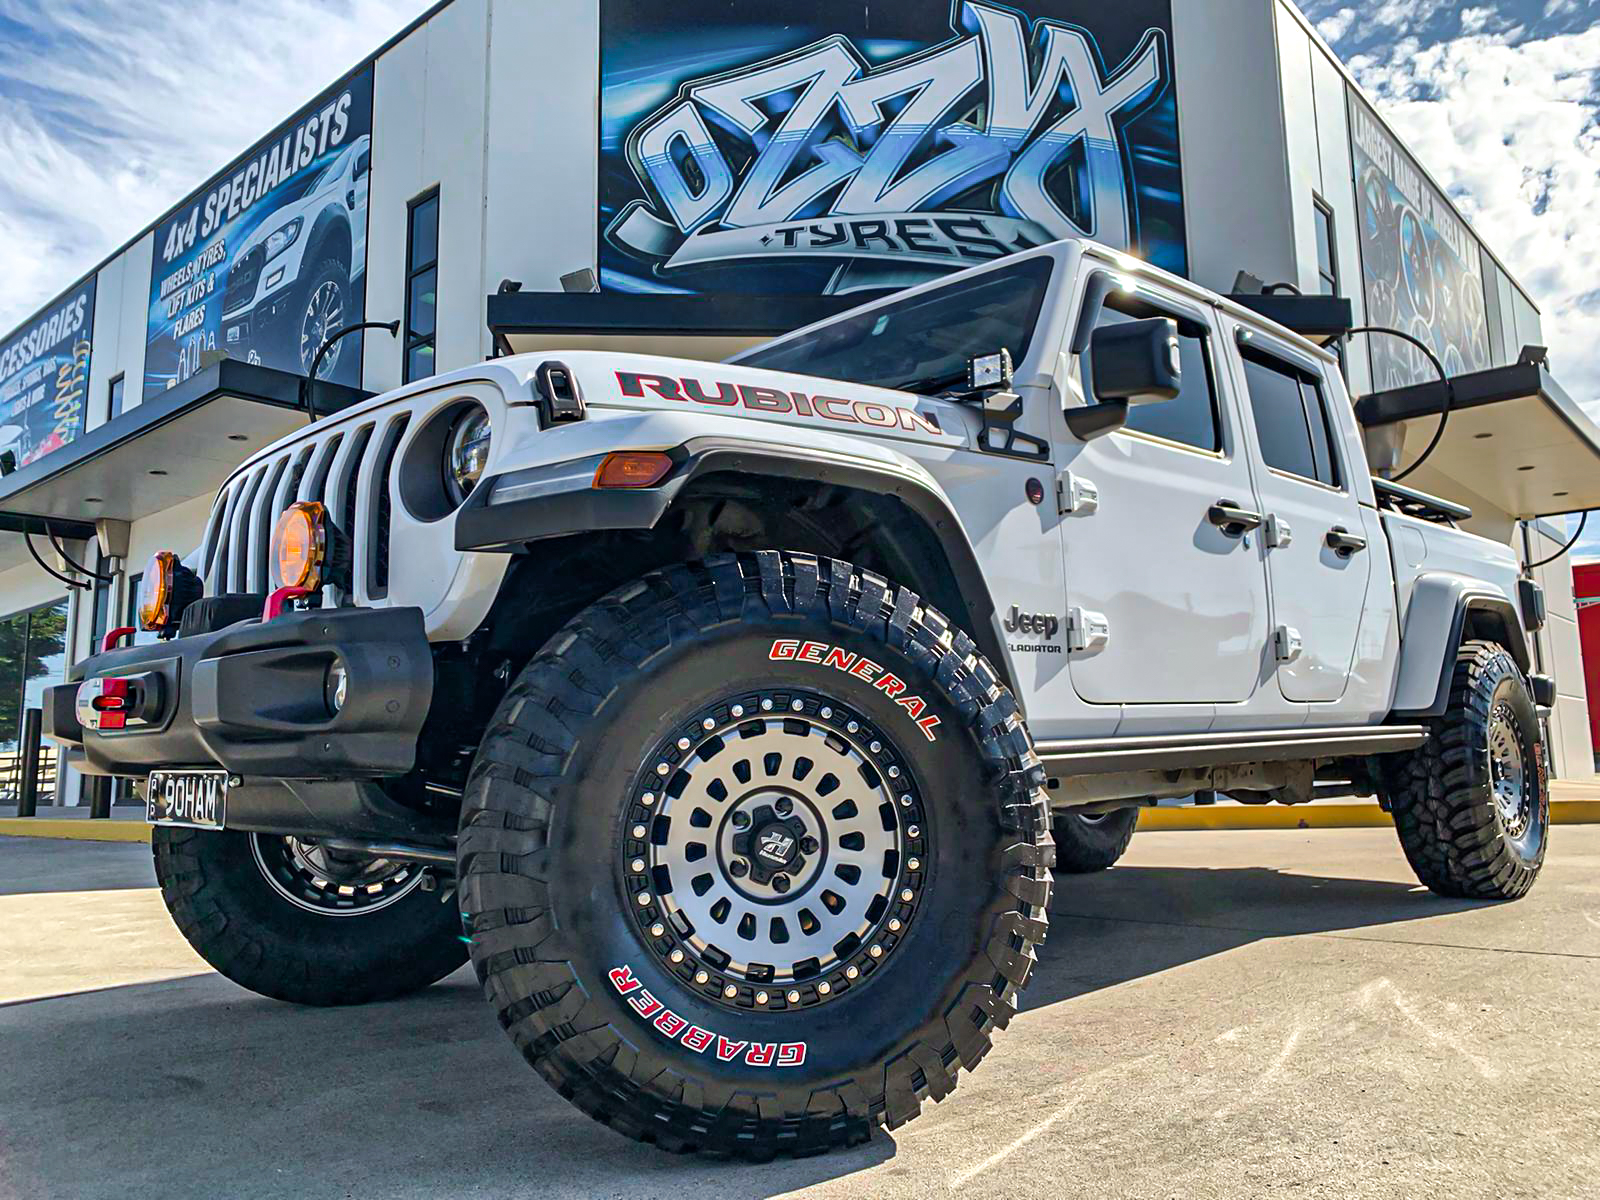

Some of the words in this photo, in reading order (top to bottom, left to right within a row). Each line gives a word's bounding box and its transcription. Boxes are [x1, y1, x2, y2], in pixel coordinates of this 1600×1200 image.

[1353, 101, 1392, 181] LARGEST
[163, 204, 200, 263] 4x4
[202, 90, 352, 238] SPECIALISTS
[775, 217, 1014, 257] TYRES
[167, 290, 186, 319] LIFT
[186, 278, 206, 308] KITS
[207, 272, 215, 293] &
[173, 304, 206, 341] FLARES
[614, 370, 942, 435] RUBICON
[1003, 603, 1058, 640] Jeep
[1008, 643, 1062, 654] LADIATOR
[768, 639, 942, 742] GENERAL
[608, 964, 807, 1067] GRABBER
